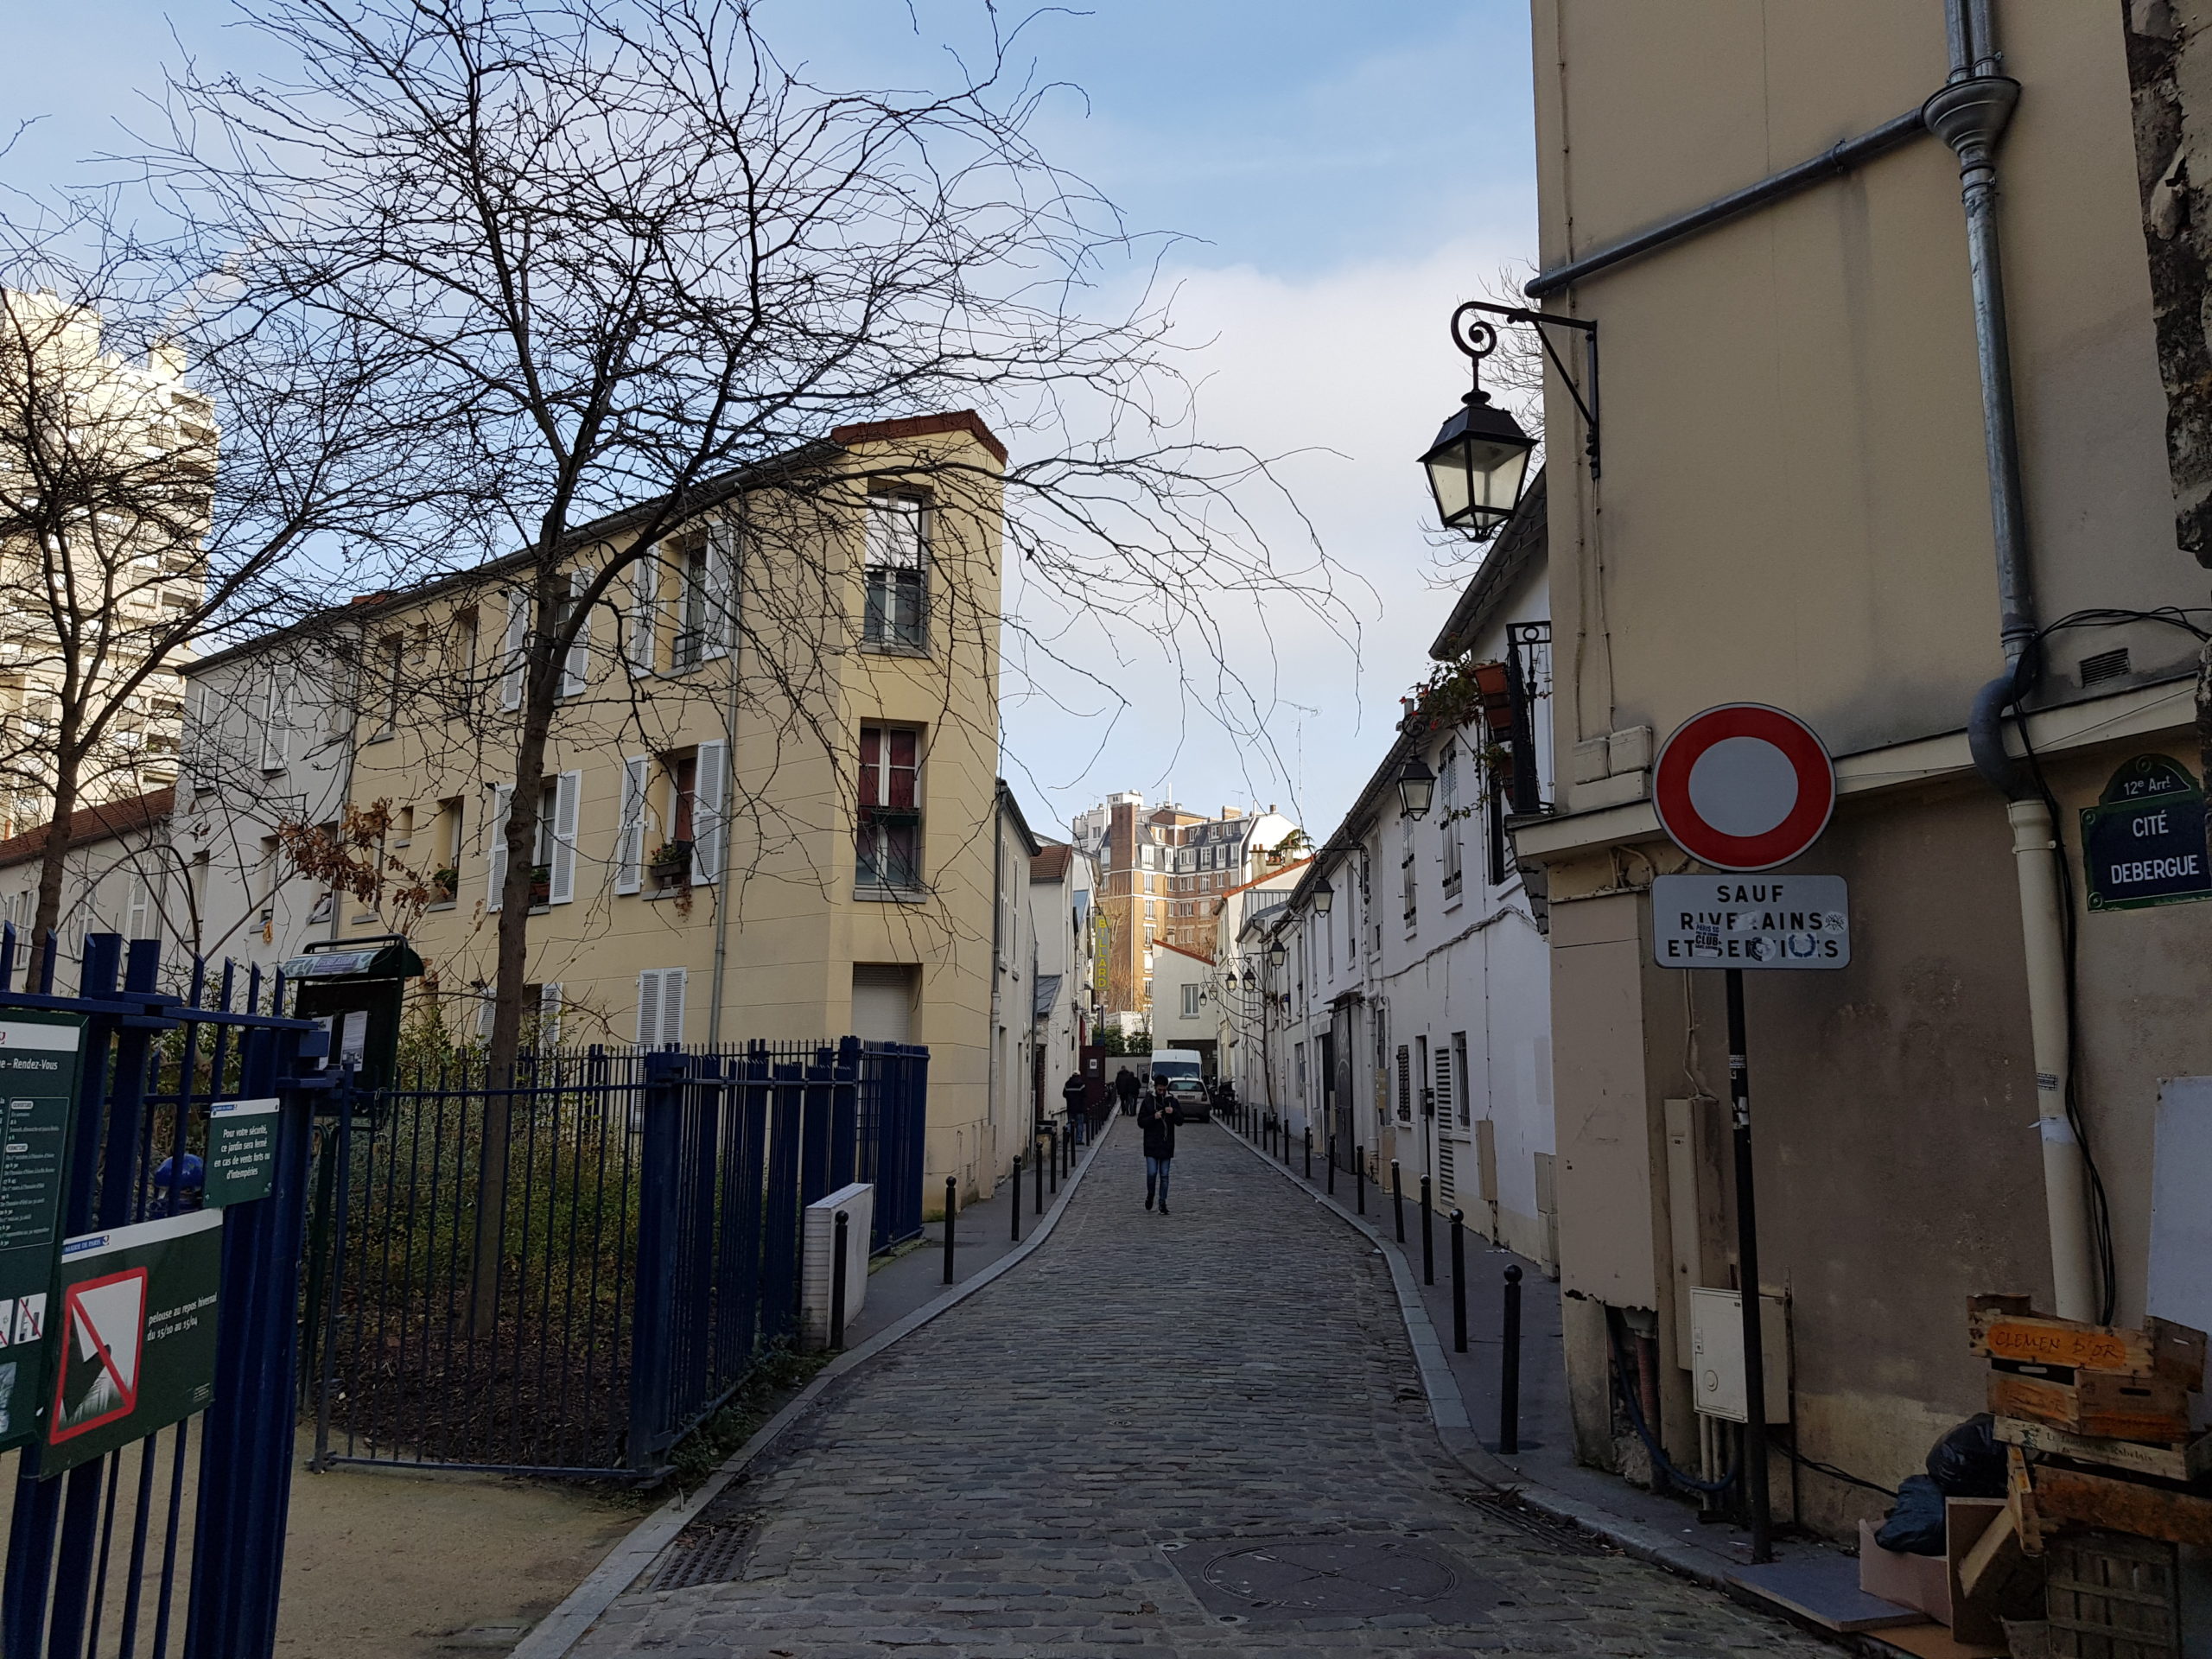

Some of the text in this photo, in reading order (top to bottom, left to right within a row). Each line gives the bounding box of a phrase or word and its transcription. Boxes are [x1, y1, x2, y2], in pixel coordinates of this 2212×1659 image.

[2132, 809, 2170, 837] CITÉ
[2110, 854, 2200, 885] DEBERGUE
[1717, 885, 1783, 903] SAUF
[1681, 912, 1822, 931] RIVEAINS
[1668, 939, 1695, 957] ET
[1695, 934, 1719, 945] CLUB
[1098, 918, 1107, 988] BILLARD
[13, 1057, 59, 1071] Rendez-Vous
[222, 1128, 235, 1139] Pour
[236, 1128, 249, 1137] votre
[227, 1141, 243, 1154] jardin
[243, 1141, 254, 1150] sera
[213, 1160, 221, 1168] en
[221, 1158, 232, 1166] cas
[232, 1155, 239, 1166] de
[239, 1154, 253, 1164] vents
[148, 1291, 218, 1327] pelouse au repos hivernal
[147, 1315, 199, 1342] du 15/10 au 15/04
[1994, 1331, 2061, 1351] CLEMEN
